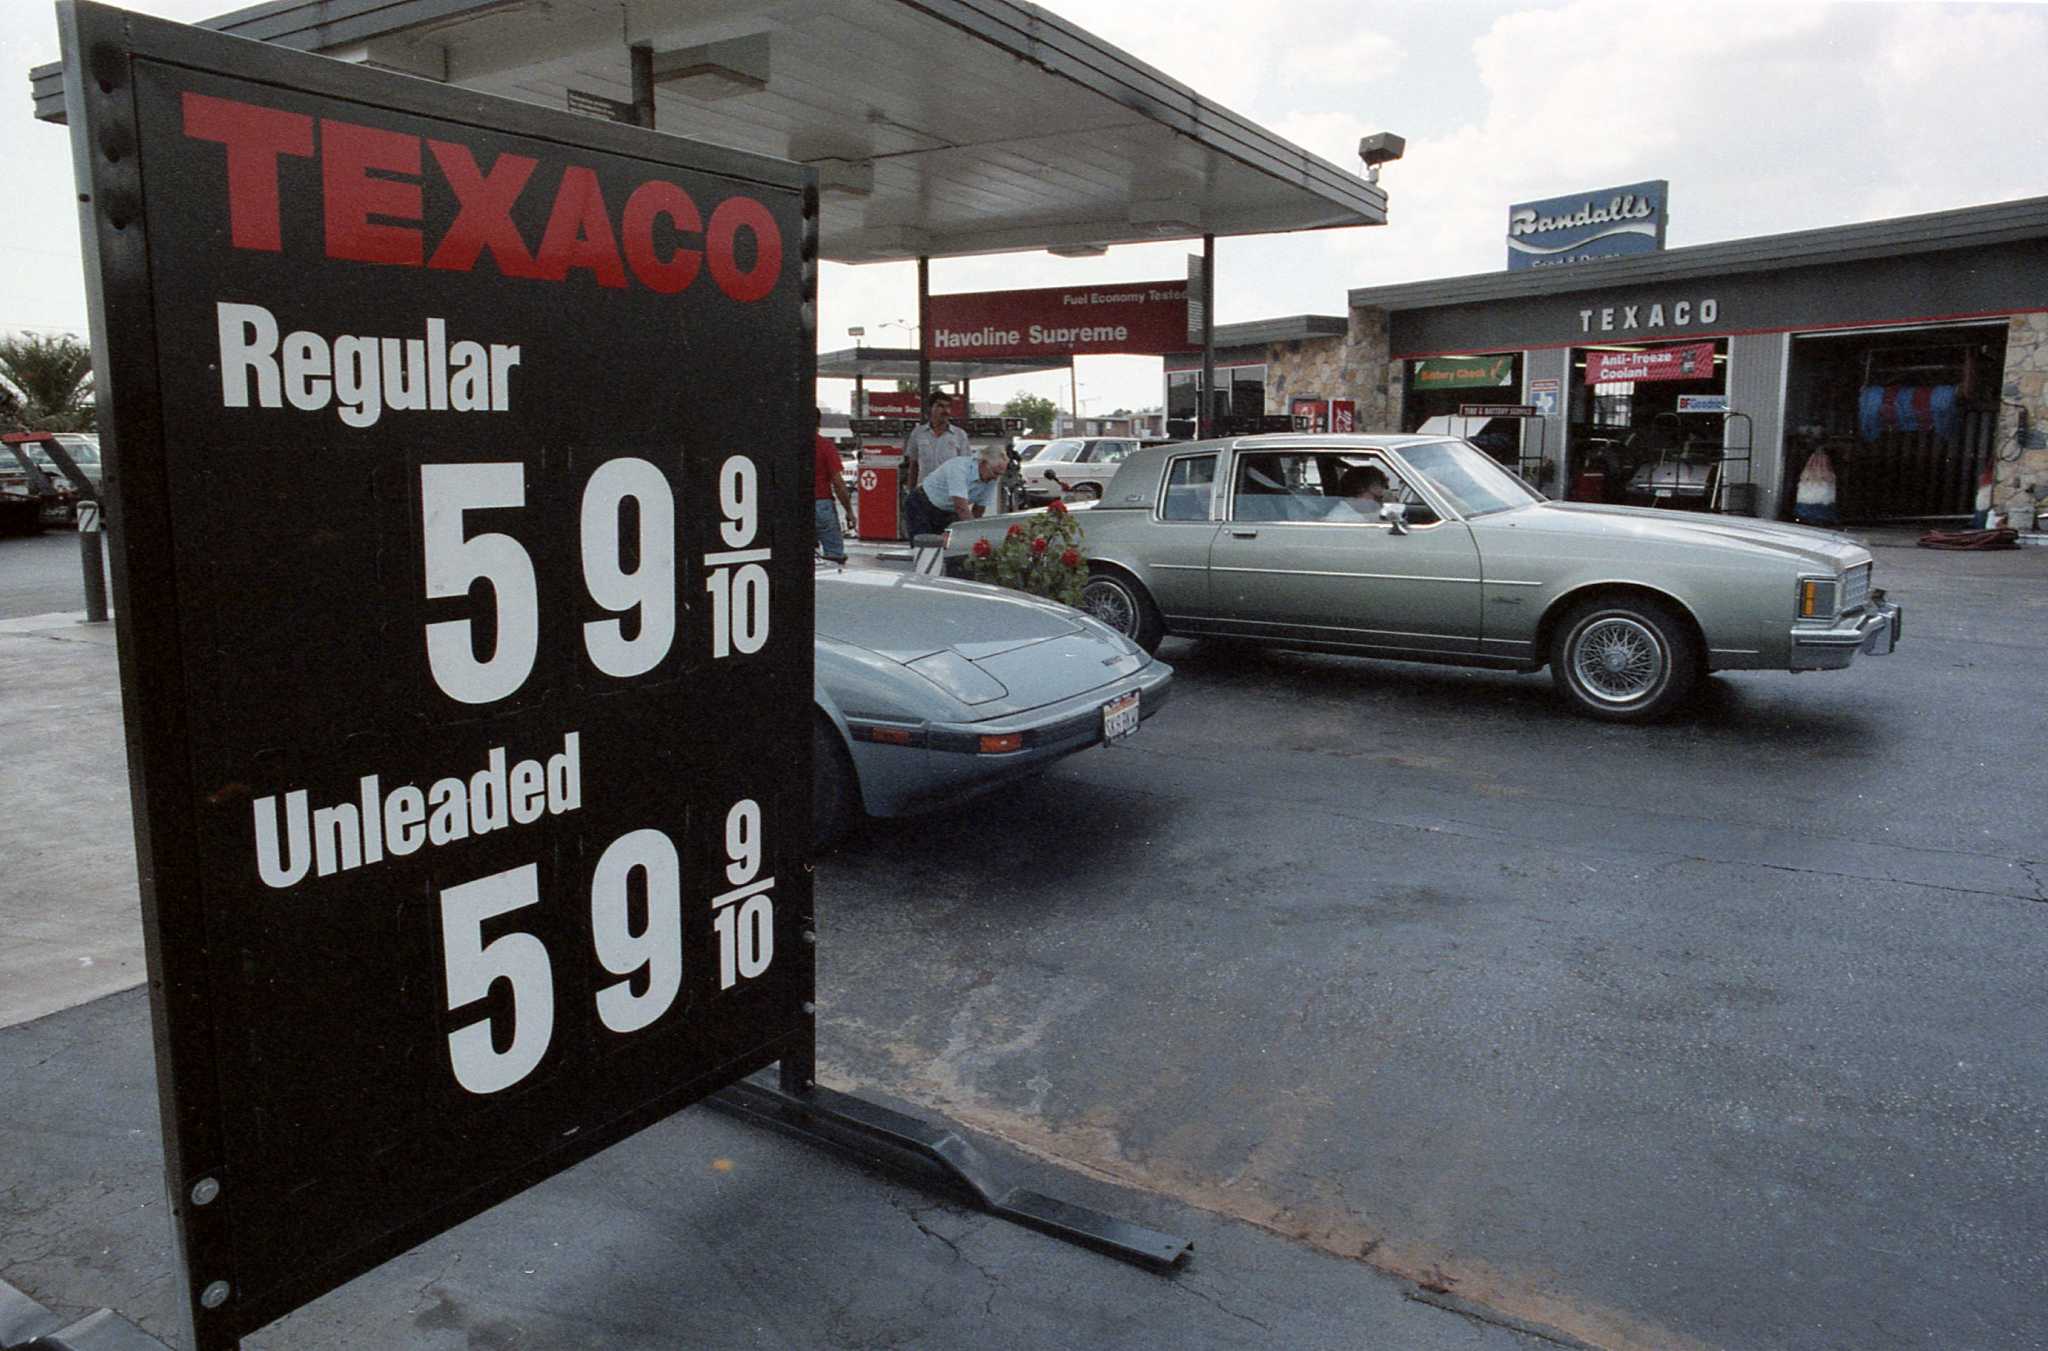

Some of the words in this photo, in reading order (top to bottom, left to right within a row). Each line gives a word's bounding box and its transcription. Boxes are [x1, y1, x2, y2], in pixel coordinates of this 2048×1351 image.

[183, 92, 783, 302] TEXACO
[1511, 195, 1652, 236] Randalls
[1063, 292, 1088, 305] Fuel
[1090, 291, 1146, 304] Economy
[1579, 298, 1718, 333] TEXACO
[934, 326, 1021, 348] Havoline
[216, 301, 521, 428] Regular
[1600, 366, 1649, 379] Coolant
[253, 731, 582, 888] Unleaded
